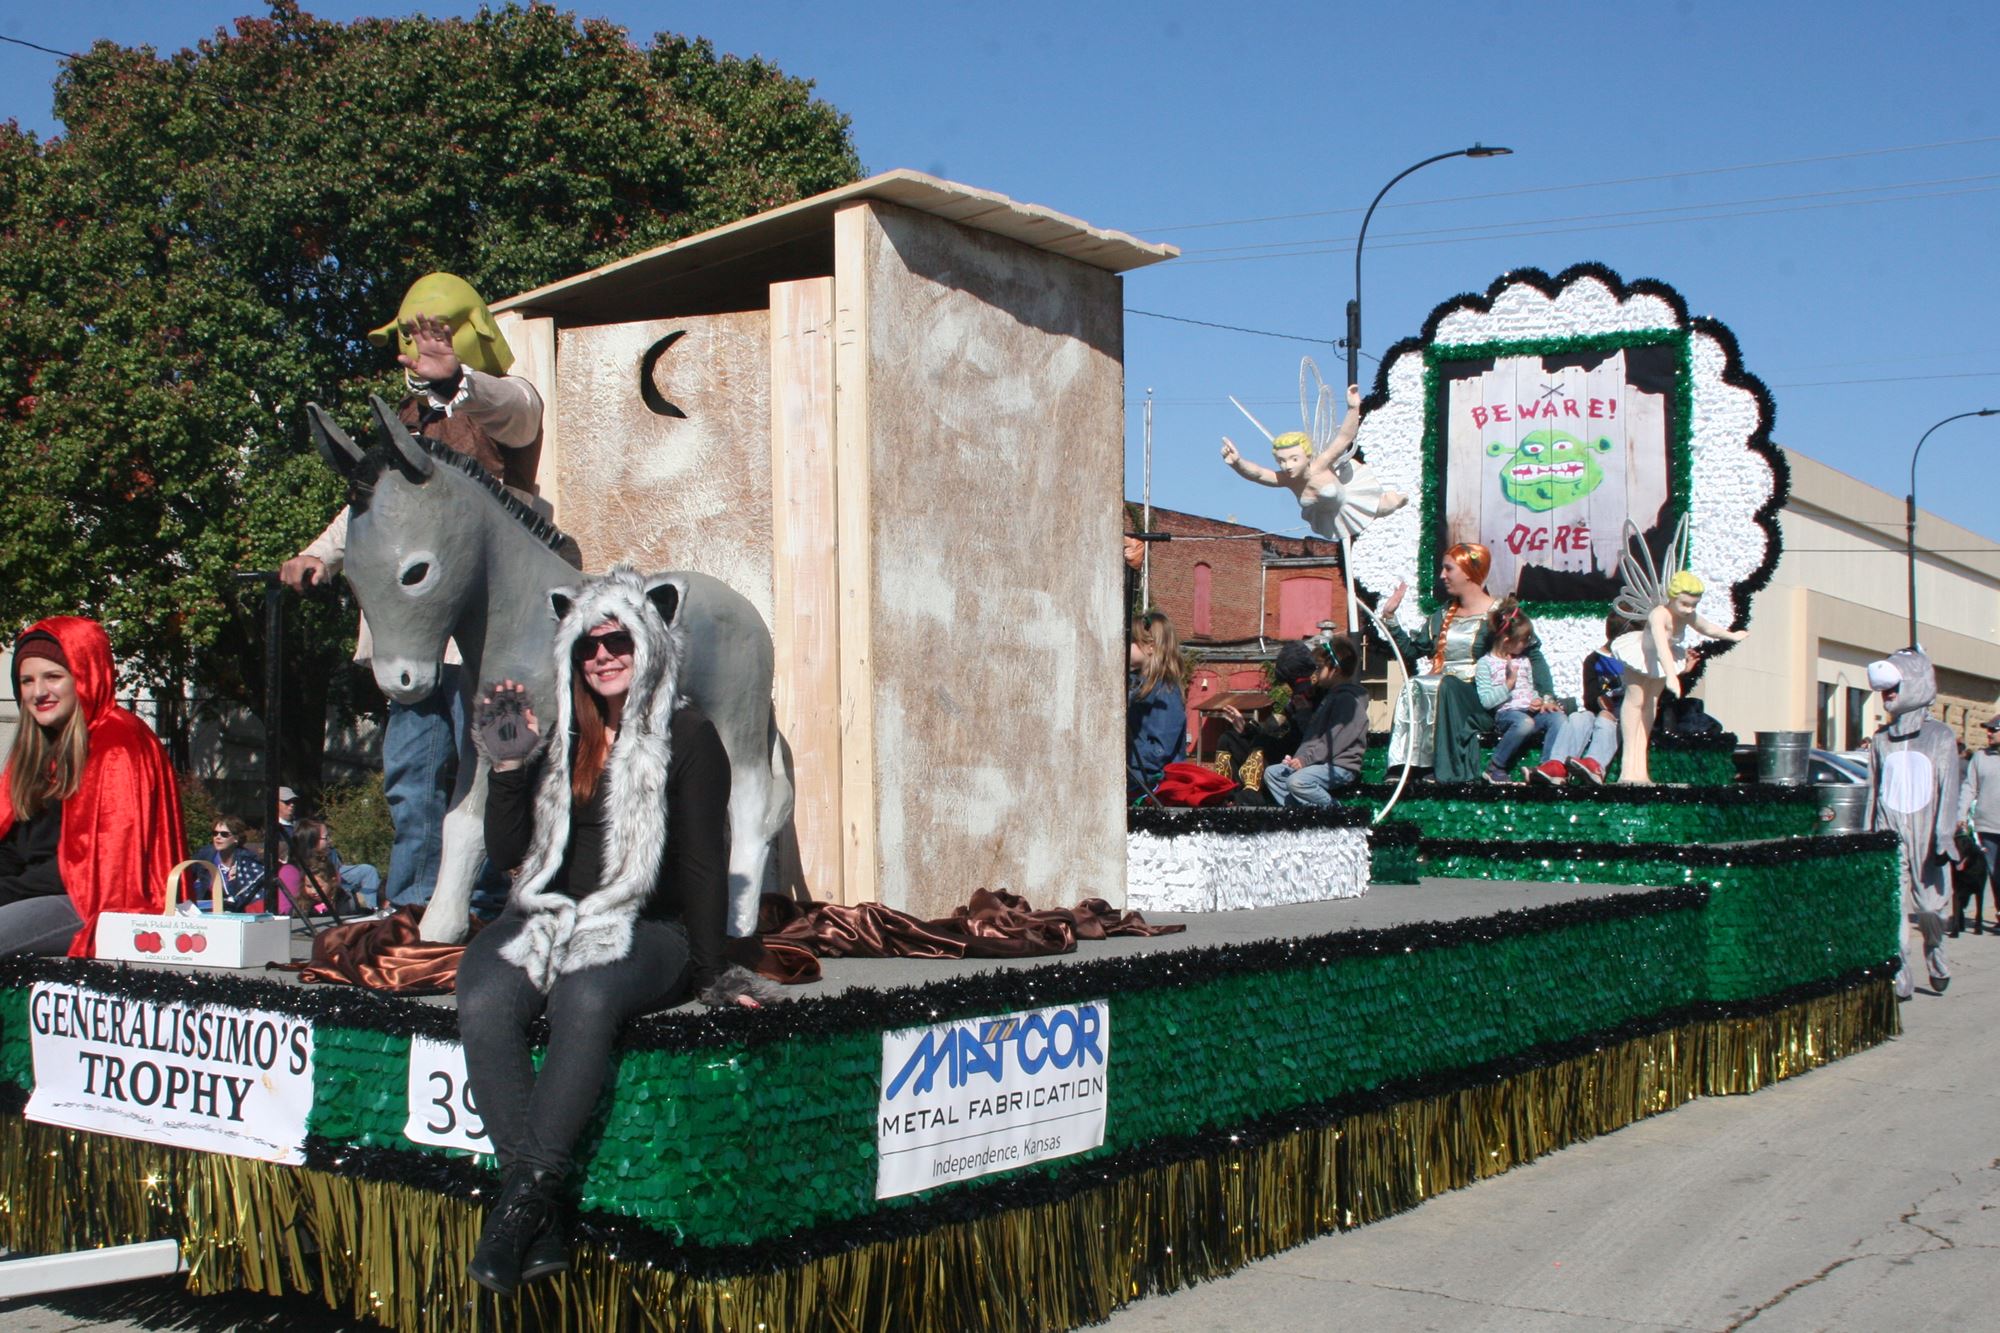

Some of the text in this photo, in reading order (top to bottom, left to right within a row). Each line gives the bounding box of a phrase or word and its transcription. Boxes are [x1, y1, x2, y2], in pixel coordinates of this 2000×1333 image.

[1471, 398, 1617, 430] BEWARE!
[1506, 523, 1591, 555] OGRE
[32, 990, 309, 1076] GENERALISSIMO'S
[886, 1005, 1104, 1101] MATCOR
[79, 1051, 254, 1122] TROPHY
[882, 1075, 1103, 1137] METAL FABRICATION
[933, 1135, 1061, 1177] Independence, Kansas
